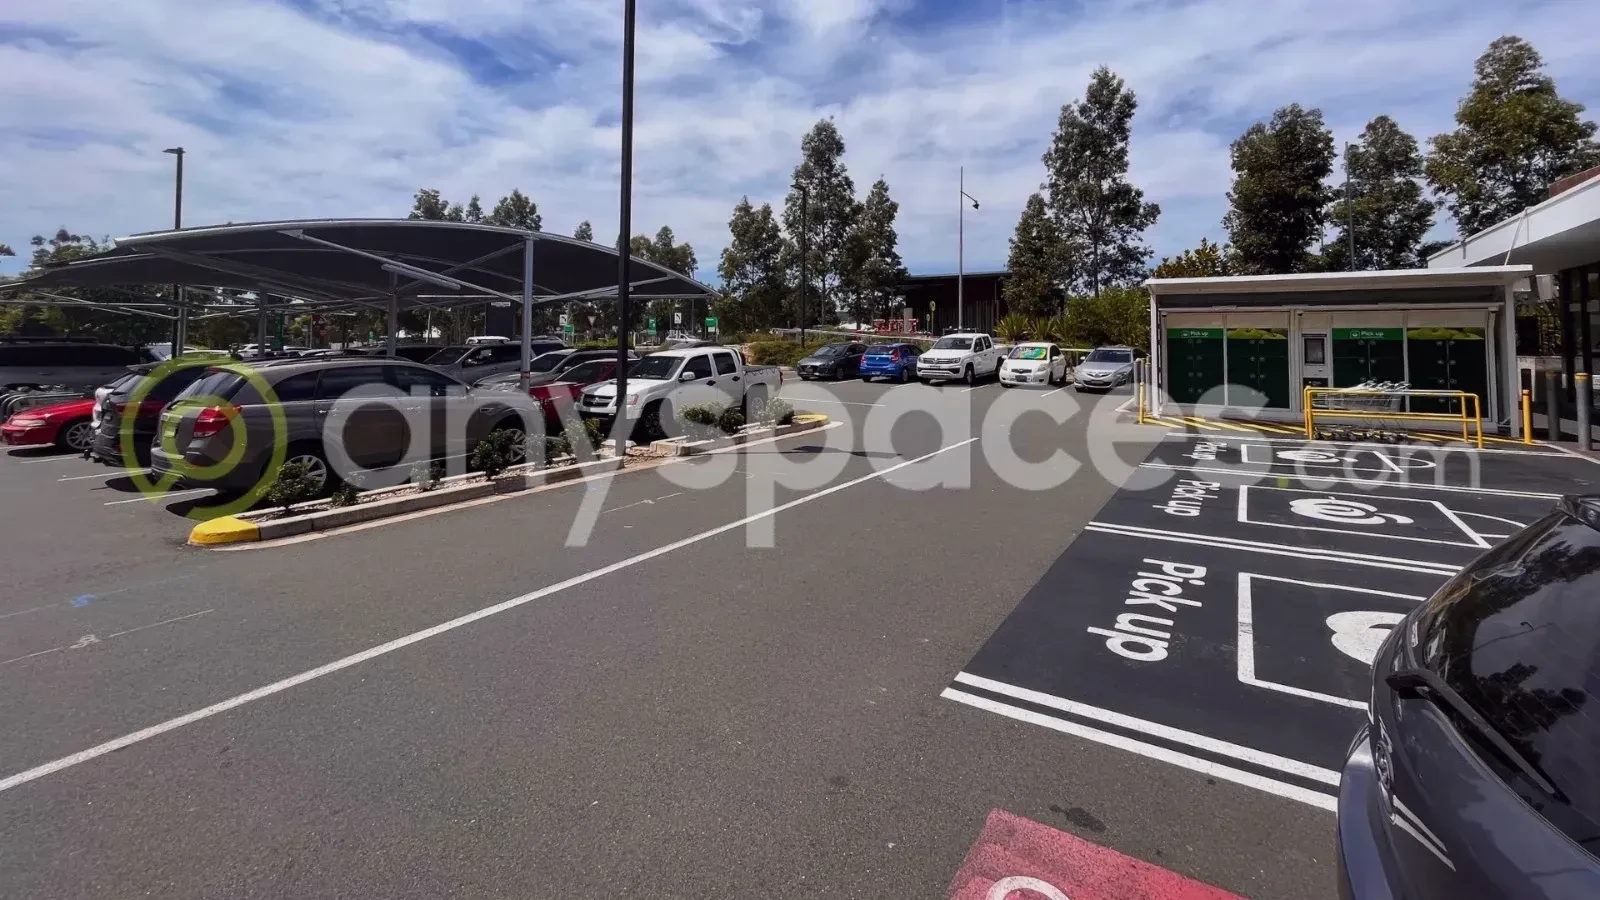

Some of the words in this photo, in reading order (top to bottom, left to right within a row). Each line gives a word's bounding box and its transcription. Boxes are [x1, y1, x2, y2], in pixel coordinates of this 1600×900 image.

[1171, 479, 1221, 501] Pick
[1152, 500, 1203, 517] up
[1124, 558, 1207, 613] Pick
[1086, 612, 1174, 662] up
